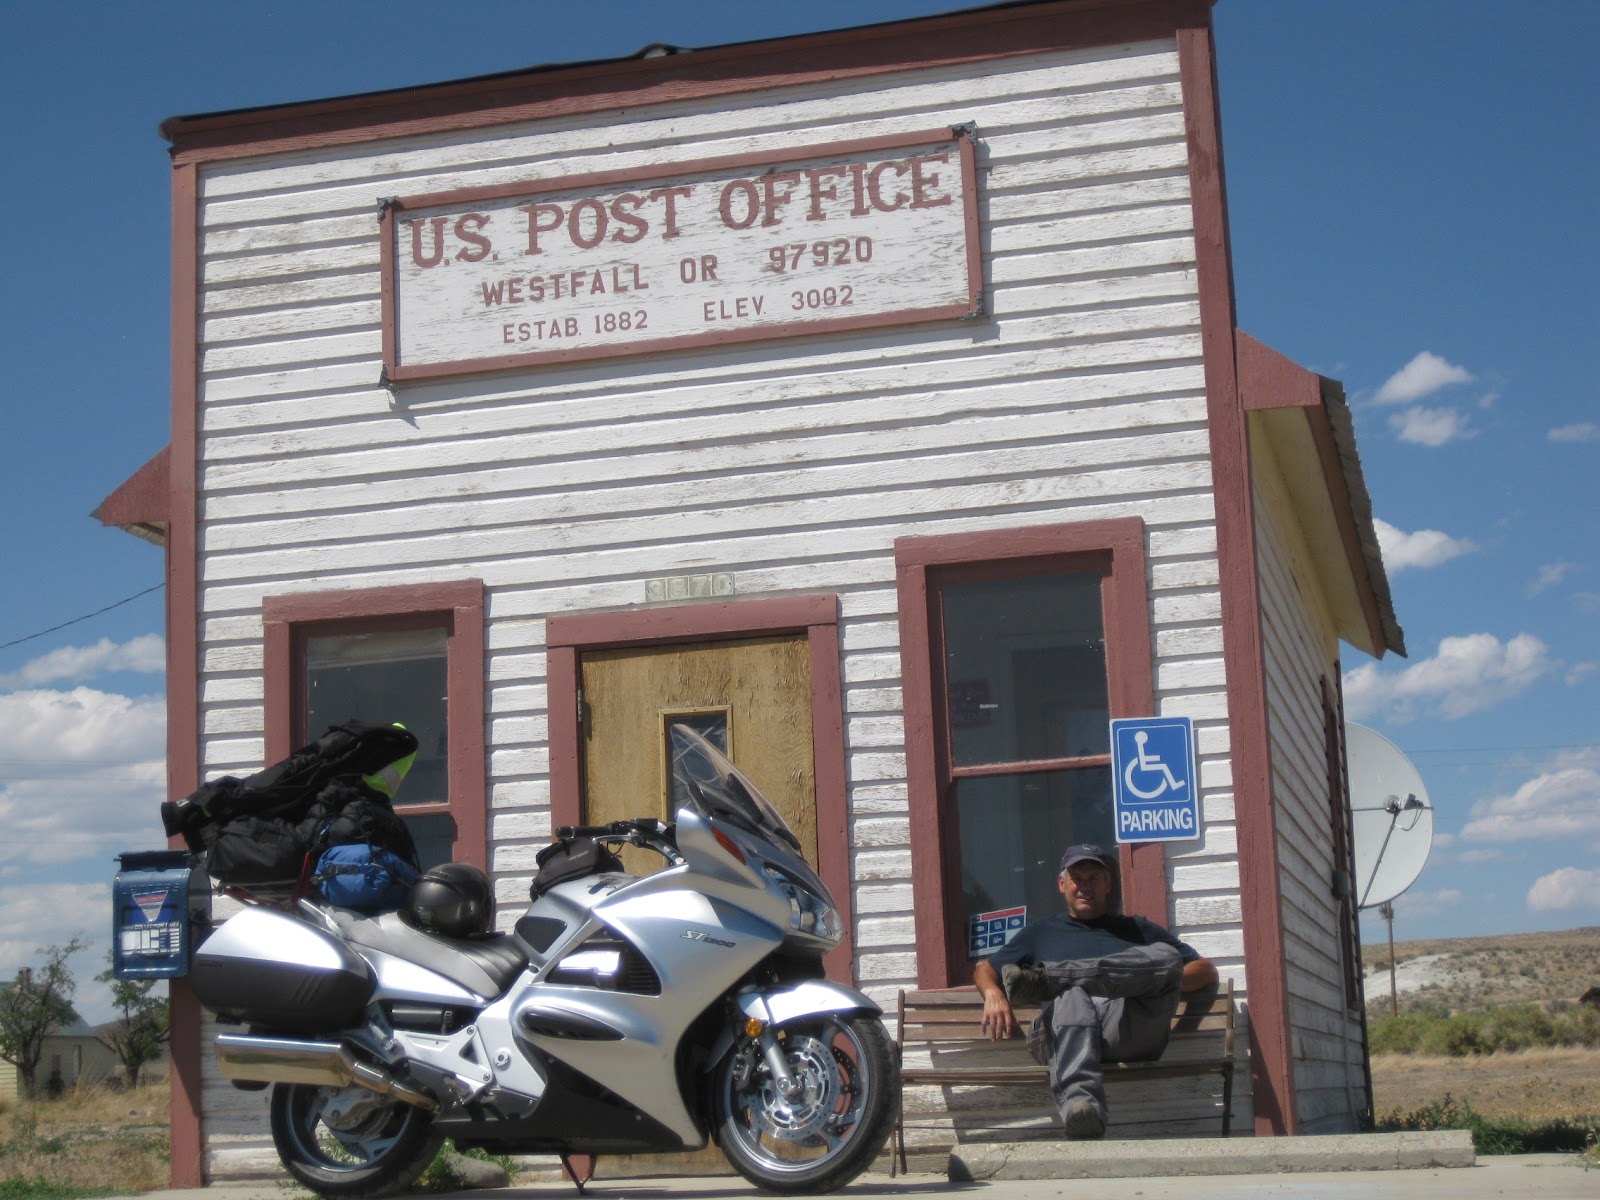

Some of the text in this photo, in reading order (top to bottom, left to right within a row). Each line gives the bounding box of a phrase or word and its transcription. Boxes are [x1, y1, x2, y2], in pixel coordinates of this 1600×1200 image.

[411, 154, 951, 268] U.S. POST OFFICE
[482, 236, 873, 307] WESTFALL OR 97920
[503, 285, 854, 344] ESTAB. 1882 ELEV. 3002
[1121, 808, 1193, 832] PARKING
